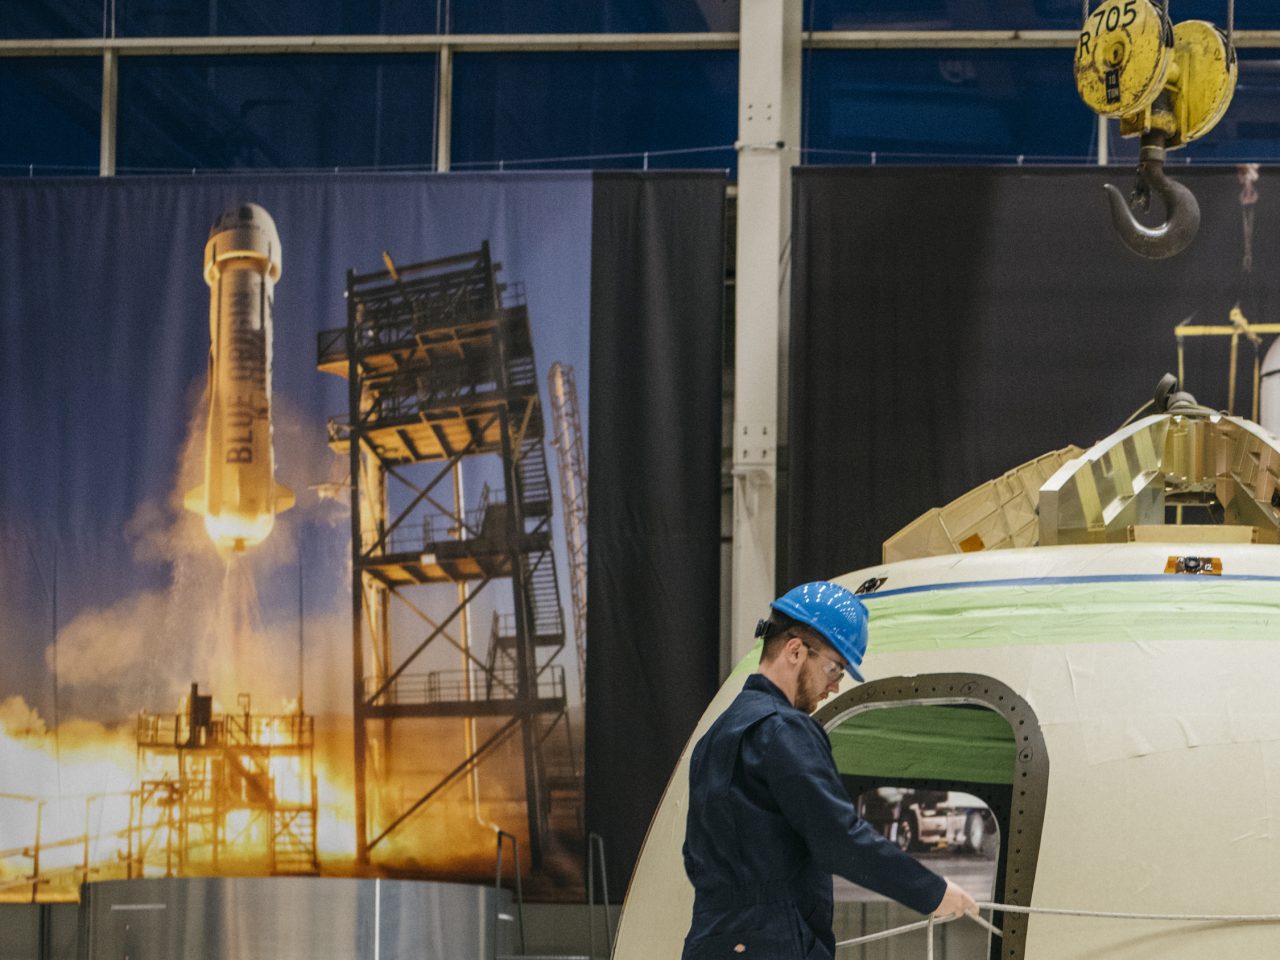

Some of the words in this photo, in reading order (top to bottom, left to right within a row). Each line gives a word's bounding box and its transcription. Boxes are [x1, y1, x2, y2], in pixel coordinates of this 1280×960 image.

[1078, 32, 1091, 60] R
[1093, 0, 1137, 38] 705
[226, 395, 253, 464] BLUE
